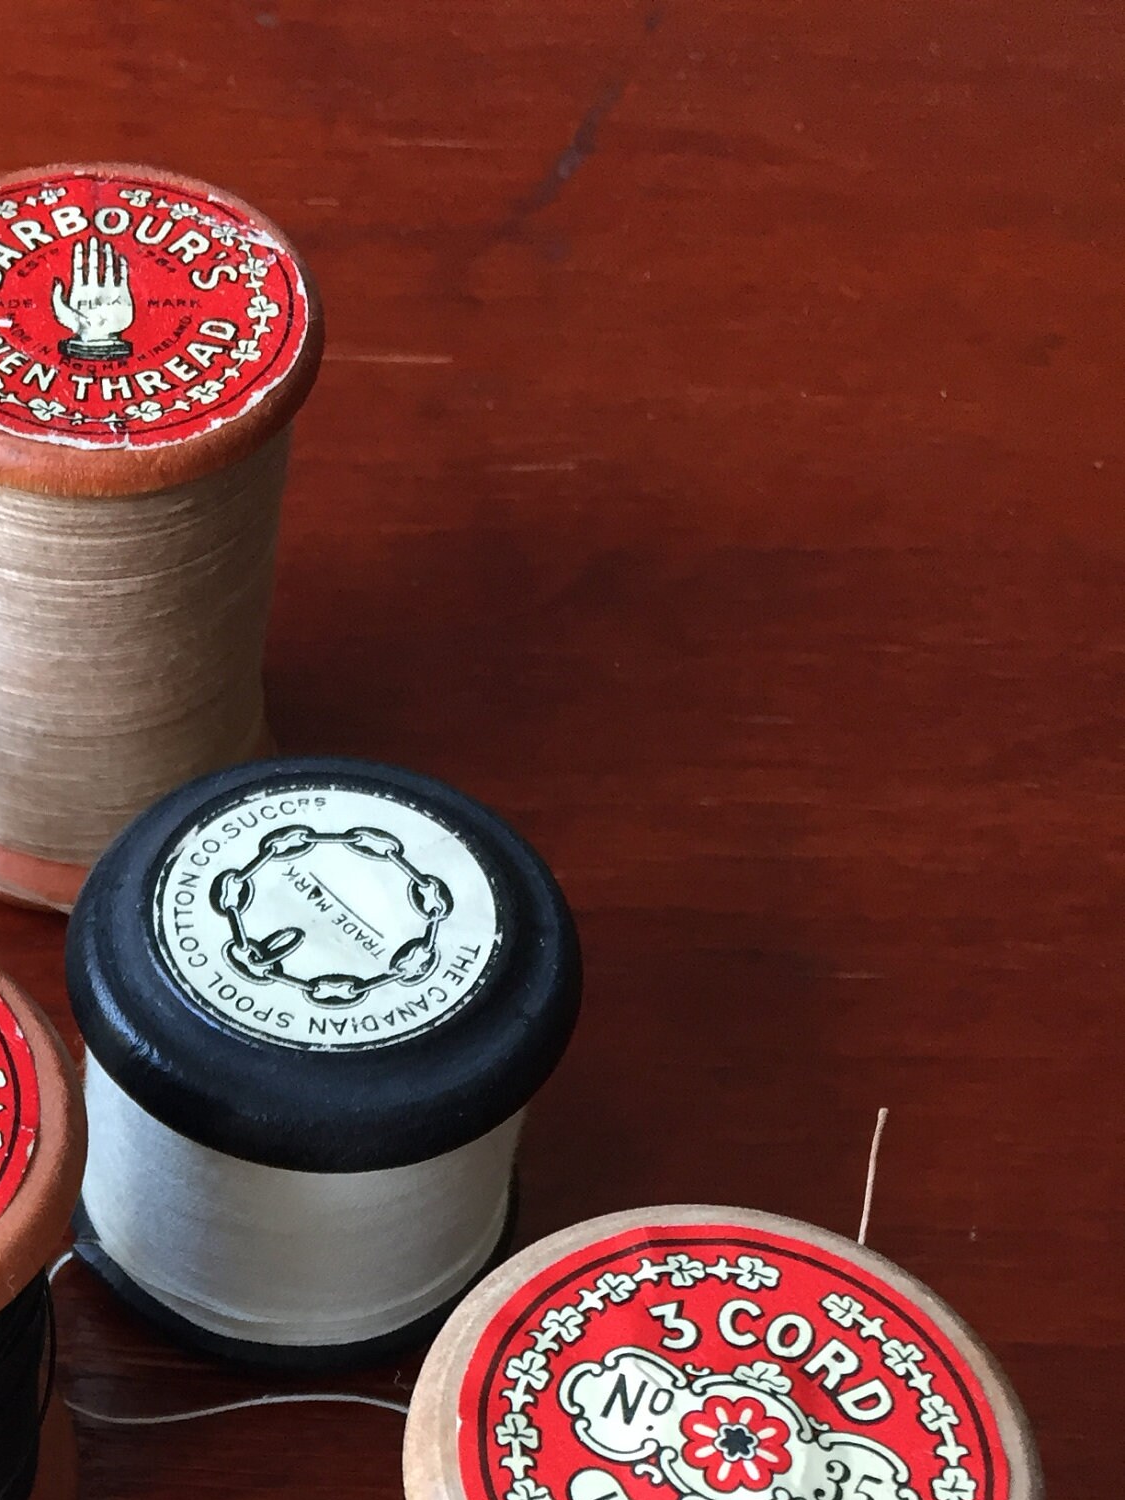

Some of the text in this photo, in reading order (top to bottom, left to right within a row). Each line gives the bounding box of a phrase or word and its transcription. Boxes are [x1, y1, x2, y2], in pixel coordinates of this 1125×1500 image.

[147, 298, 202, 309] MARK
[71, 318, 237, 401] THREAD
[175, 872, 209, 969] COTTON
[331, 912, 388, 961] TRADE
[443, 943, 482, 987] THE
[207, 971, 296, 1029] SPOOL
[307, 985, 449, 1036] CANADIAN
[648, 1299, 895, 1422] 3 CORD
